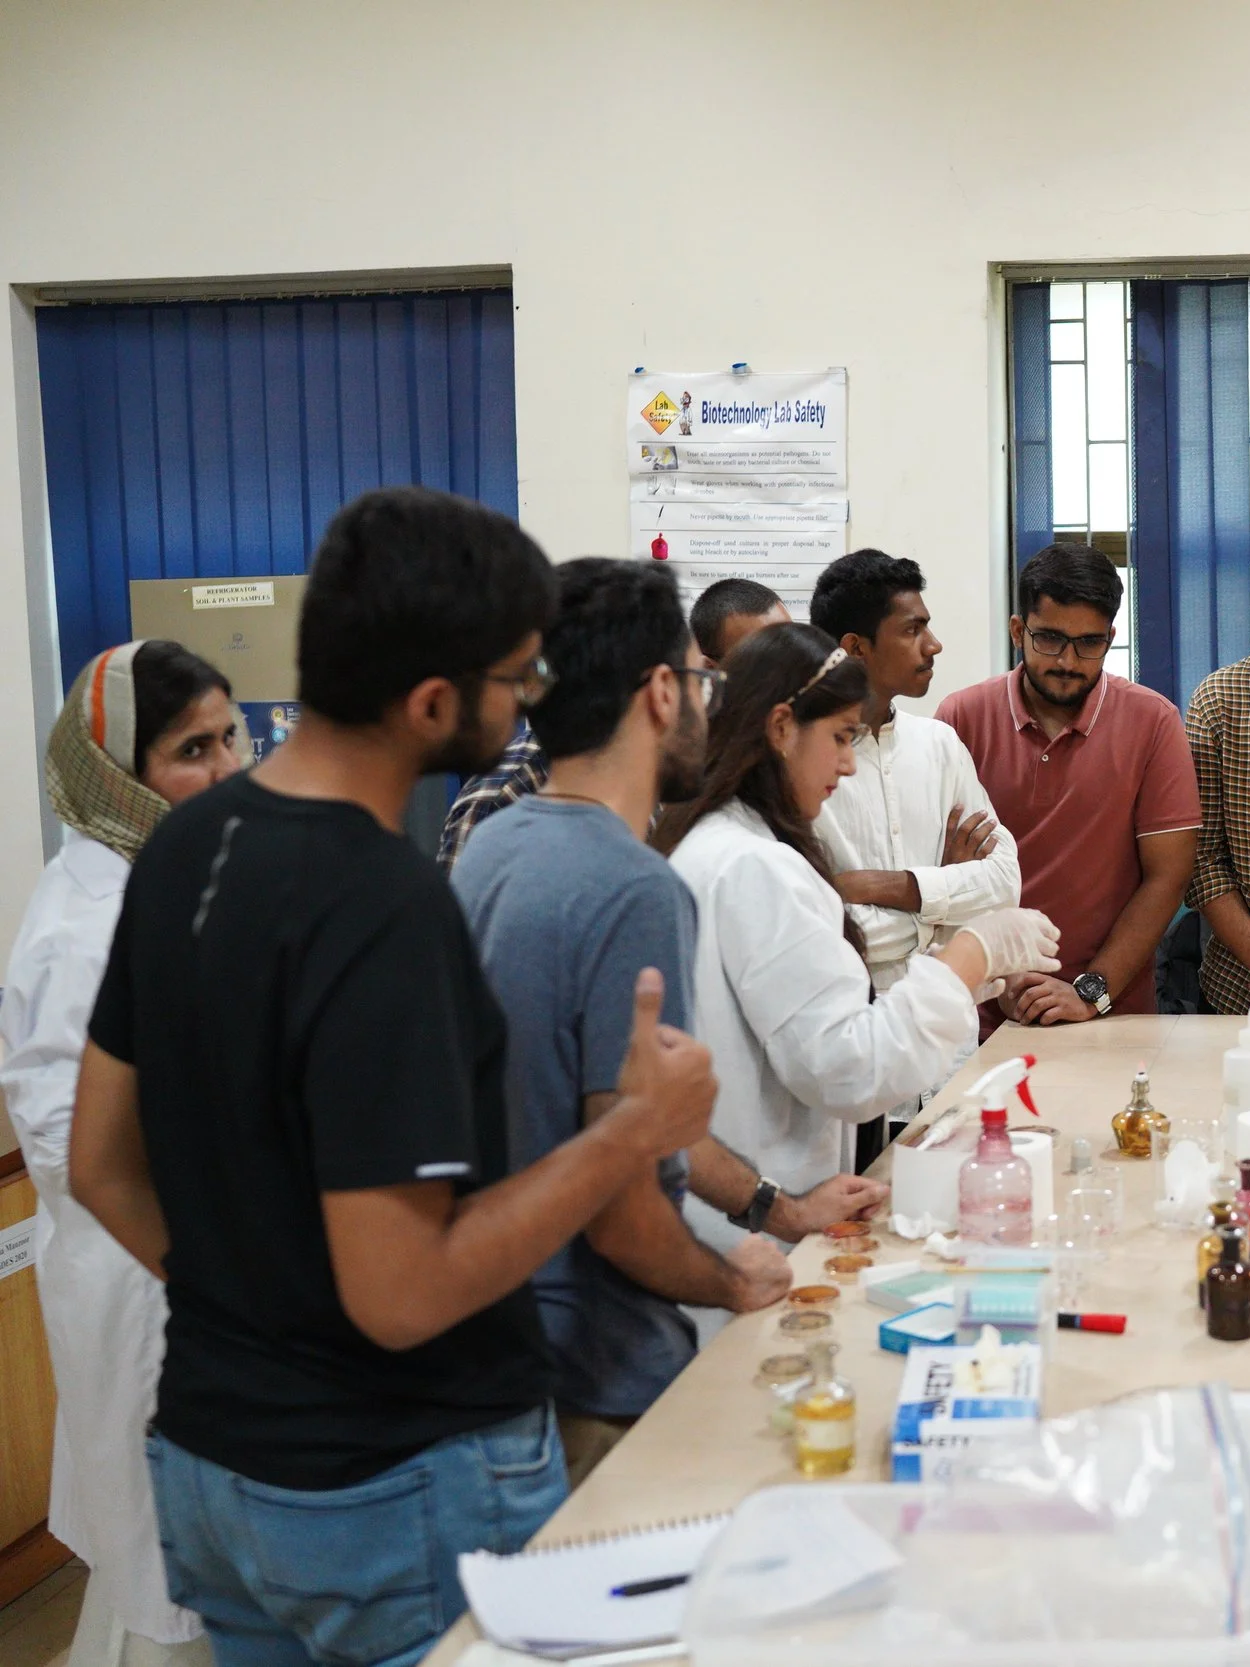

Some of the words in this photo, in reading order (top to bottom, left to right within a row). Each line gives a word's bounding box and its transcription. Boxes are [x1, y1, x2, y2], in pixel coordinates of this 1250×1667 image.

[655, 400, 668, 410] Lab
[702, 401, 771, 429] Biotechnology
[774, 401, 792, 423] Lab
[794, 400, 826, 429] Safety
[207, 586, 257, 594] REFRIGERATOR
[921, 1361, 953, 1414] SAFETY
